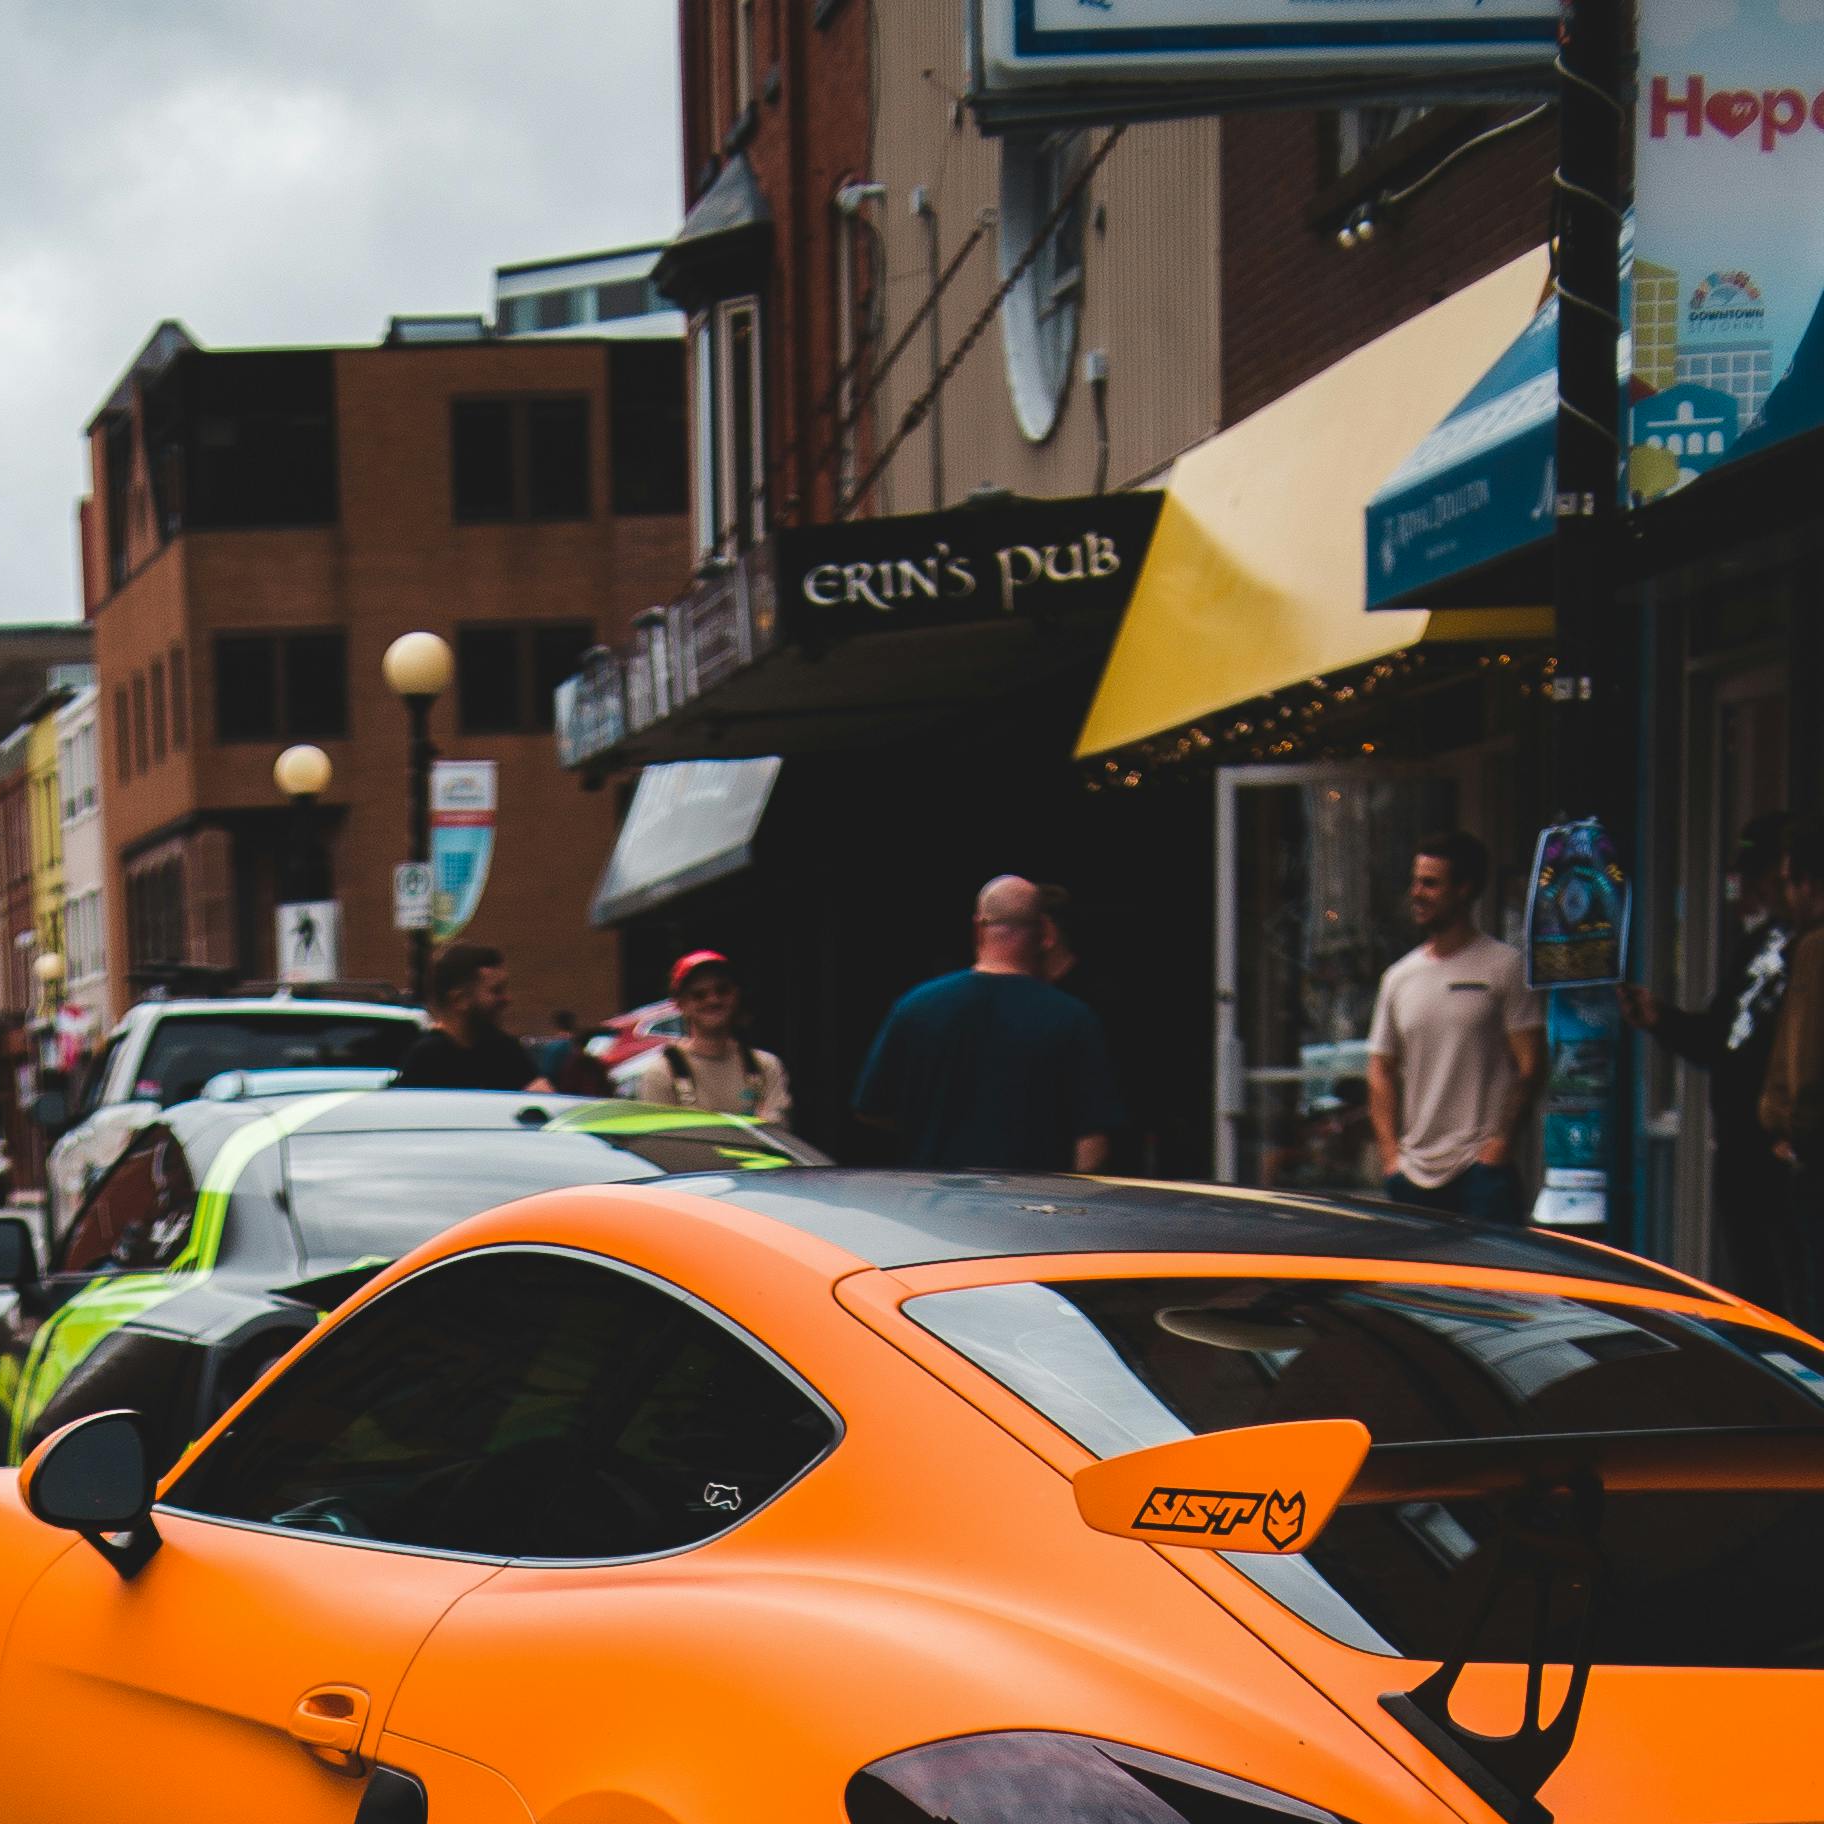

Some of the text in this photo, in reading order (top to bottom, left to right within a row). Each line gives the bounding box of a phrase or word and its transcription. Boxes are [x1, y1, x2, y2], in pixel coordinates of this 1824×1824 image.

[1688, 308, 1765, 321] DOWNTOWN
[802, 532, 1121, 611] ERIN'S PUB
